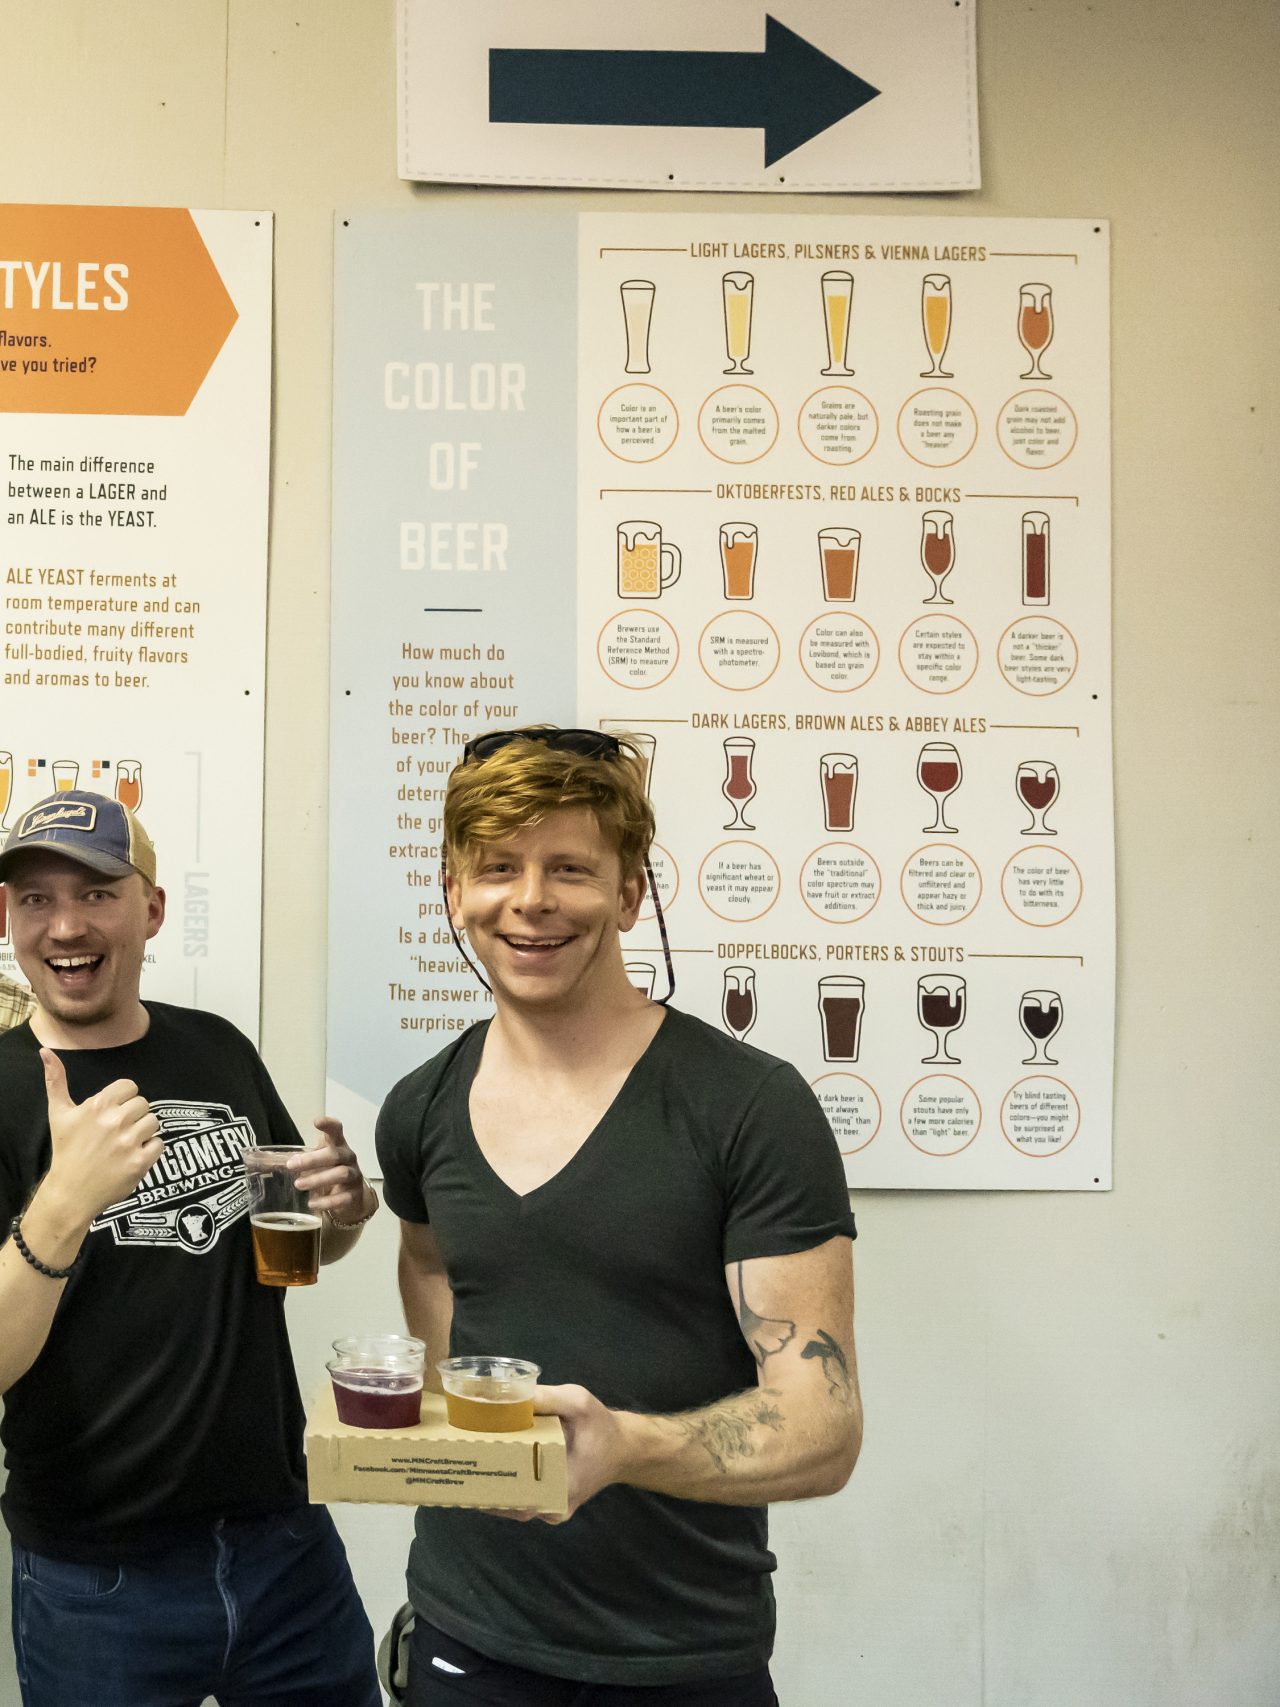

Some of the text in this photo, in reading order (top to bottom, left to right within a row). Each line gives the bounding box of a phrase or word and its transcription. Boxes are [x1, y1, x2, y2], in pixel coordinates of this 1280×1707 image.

[690, 242, 986, 262] LIGHT LAGERS, PILSNERS & VIENNA LAGERS
[416, 282, 496, 329] THE
[385, 363, 526, 410] COLOR
[715, 404, 721, 413] A
[722, 405, 743, 413] beer's
[8, 453, 155, 474] The main difference
[431, 442, 481, 489] OF
[8, 481, 167, 501] between a LAGER and
[716, 483, 961, 503] OKTOBERFESTS, RED ALES & BOCKS
[7, 508, 157, 527] an ALE is the YEAST.
[400, 522, 508, 570] BEER
[402, 642, 505, 661] How much do
[392, 671, 514, 691] you know about
[692, 712, 987, 733] DARK LAGERS, BROWN ALES & ABBEY ALES
[183, 872, 210, 957] LAGERS
[717, 943, 964, 962] DOPPELBOCKS, PORTERS & STOUTS
[135, 1125, 254, 1192] TGOMERY
[138, 1166, 236, 1206] BREWING
